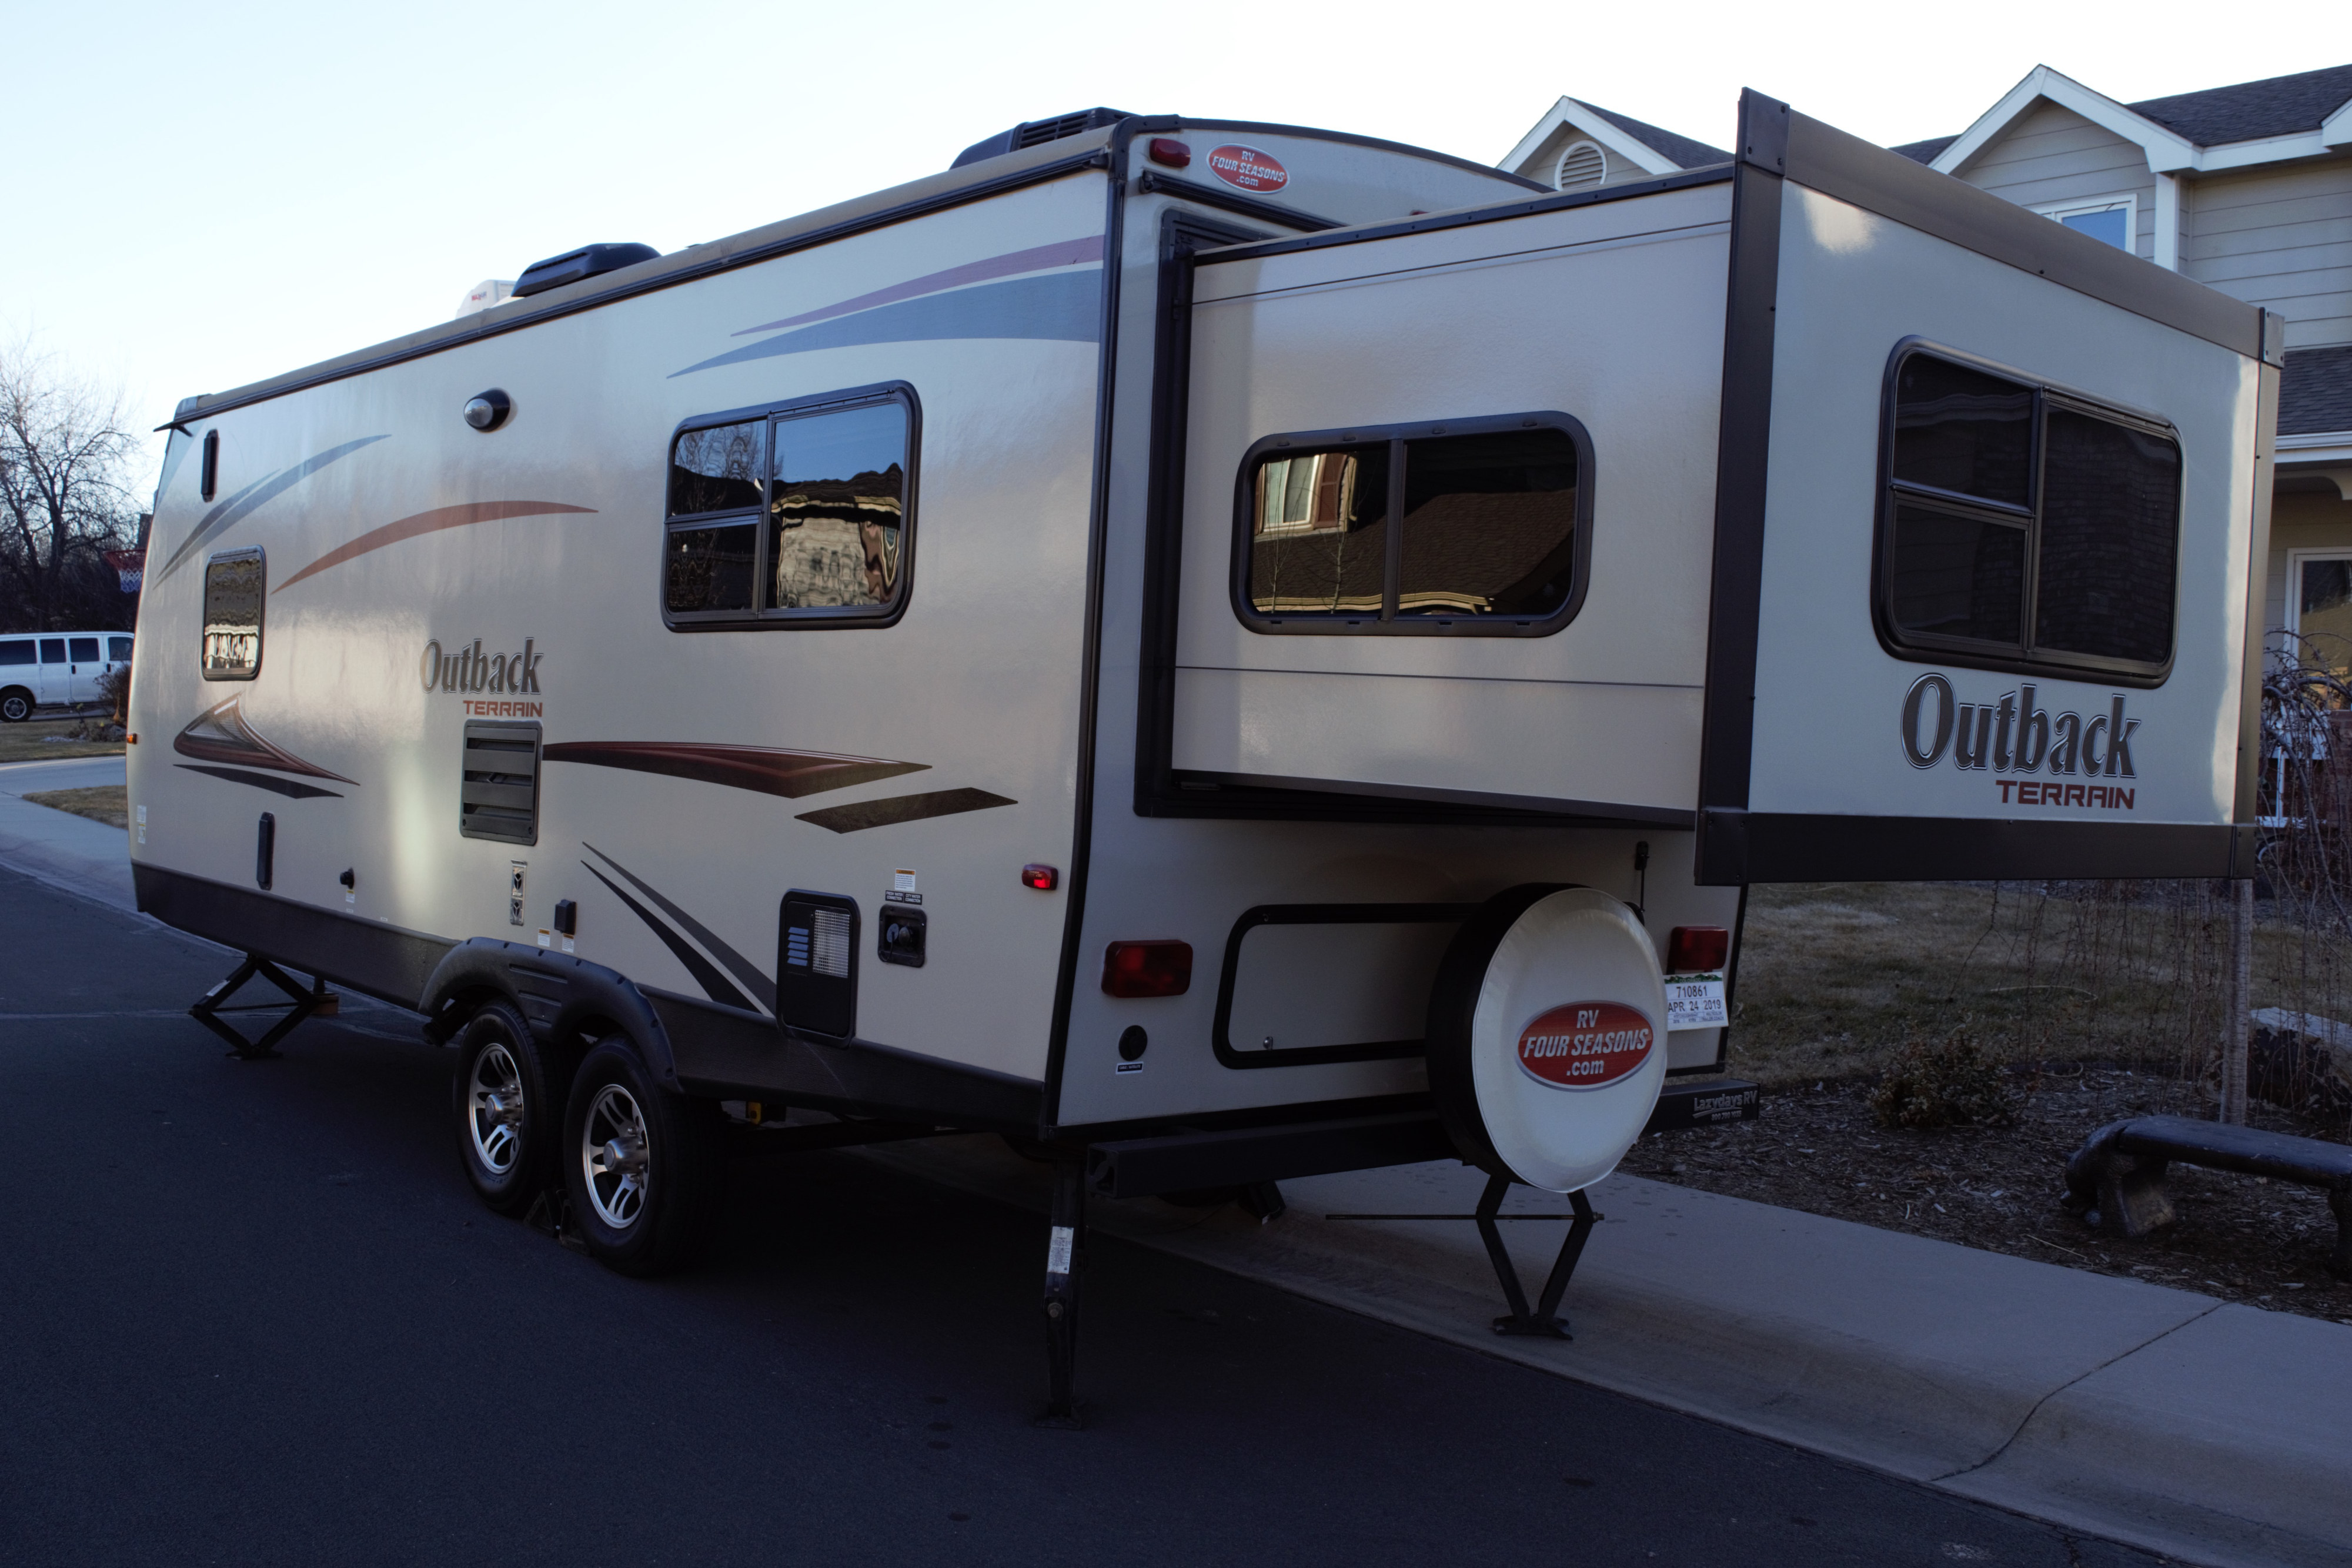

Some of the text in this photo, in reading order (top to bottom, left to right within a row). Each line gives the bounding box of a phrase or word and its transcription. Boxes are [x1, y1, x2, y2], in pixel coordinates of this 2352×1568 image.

[1242, 151, 1255, 162] RV
[1212, 156, 1285, 182] FOUR SEASONS
[1236, 176, 1258, 186] .com
[420, 637, 544, 695] Outback
[463, 700, 543, 717] TERRAIN
[1902, 672, 2141, 778] Outback
[1996, 780, 2135, 810] TERRAIN
[1676, 985, 1707, 998] 710861
[1668, 999, 1721, 1012] APR 24 2019
[1576, 1009, 1599, 1028] RV
[1524, 1028, 1649, 1058] FOUR SEASONS
[1566, 1060, 1604, 1076] .com
